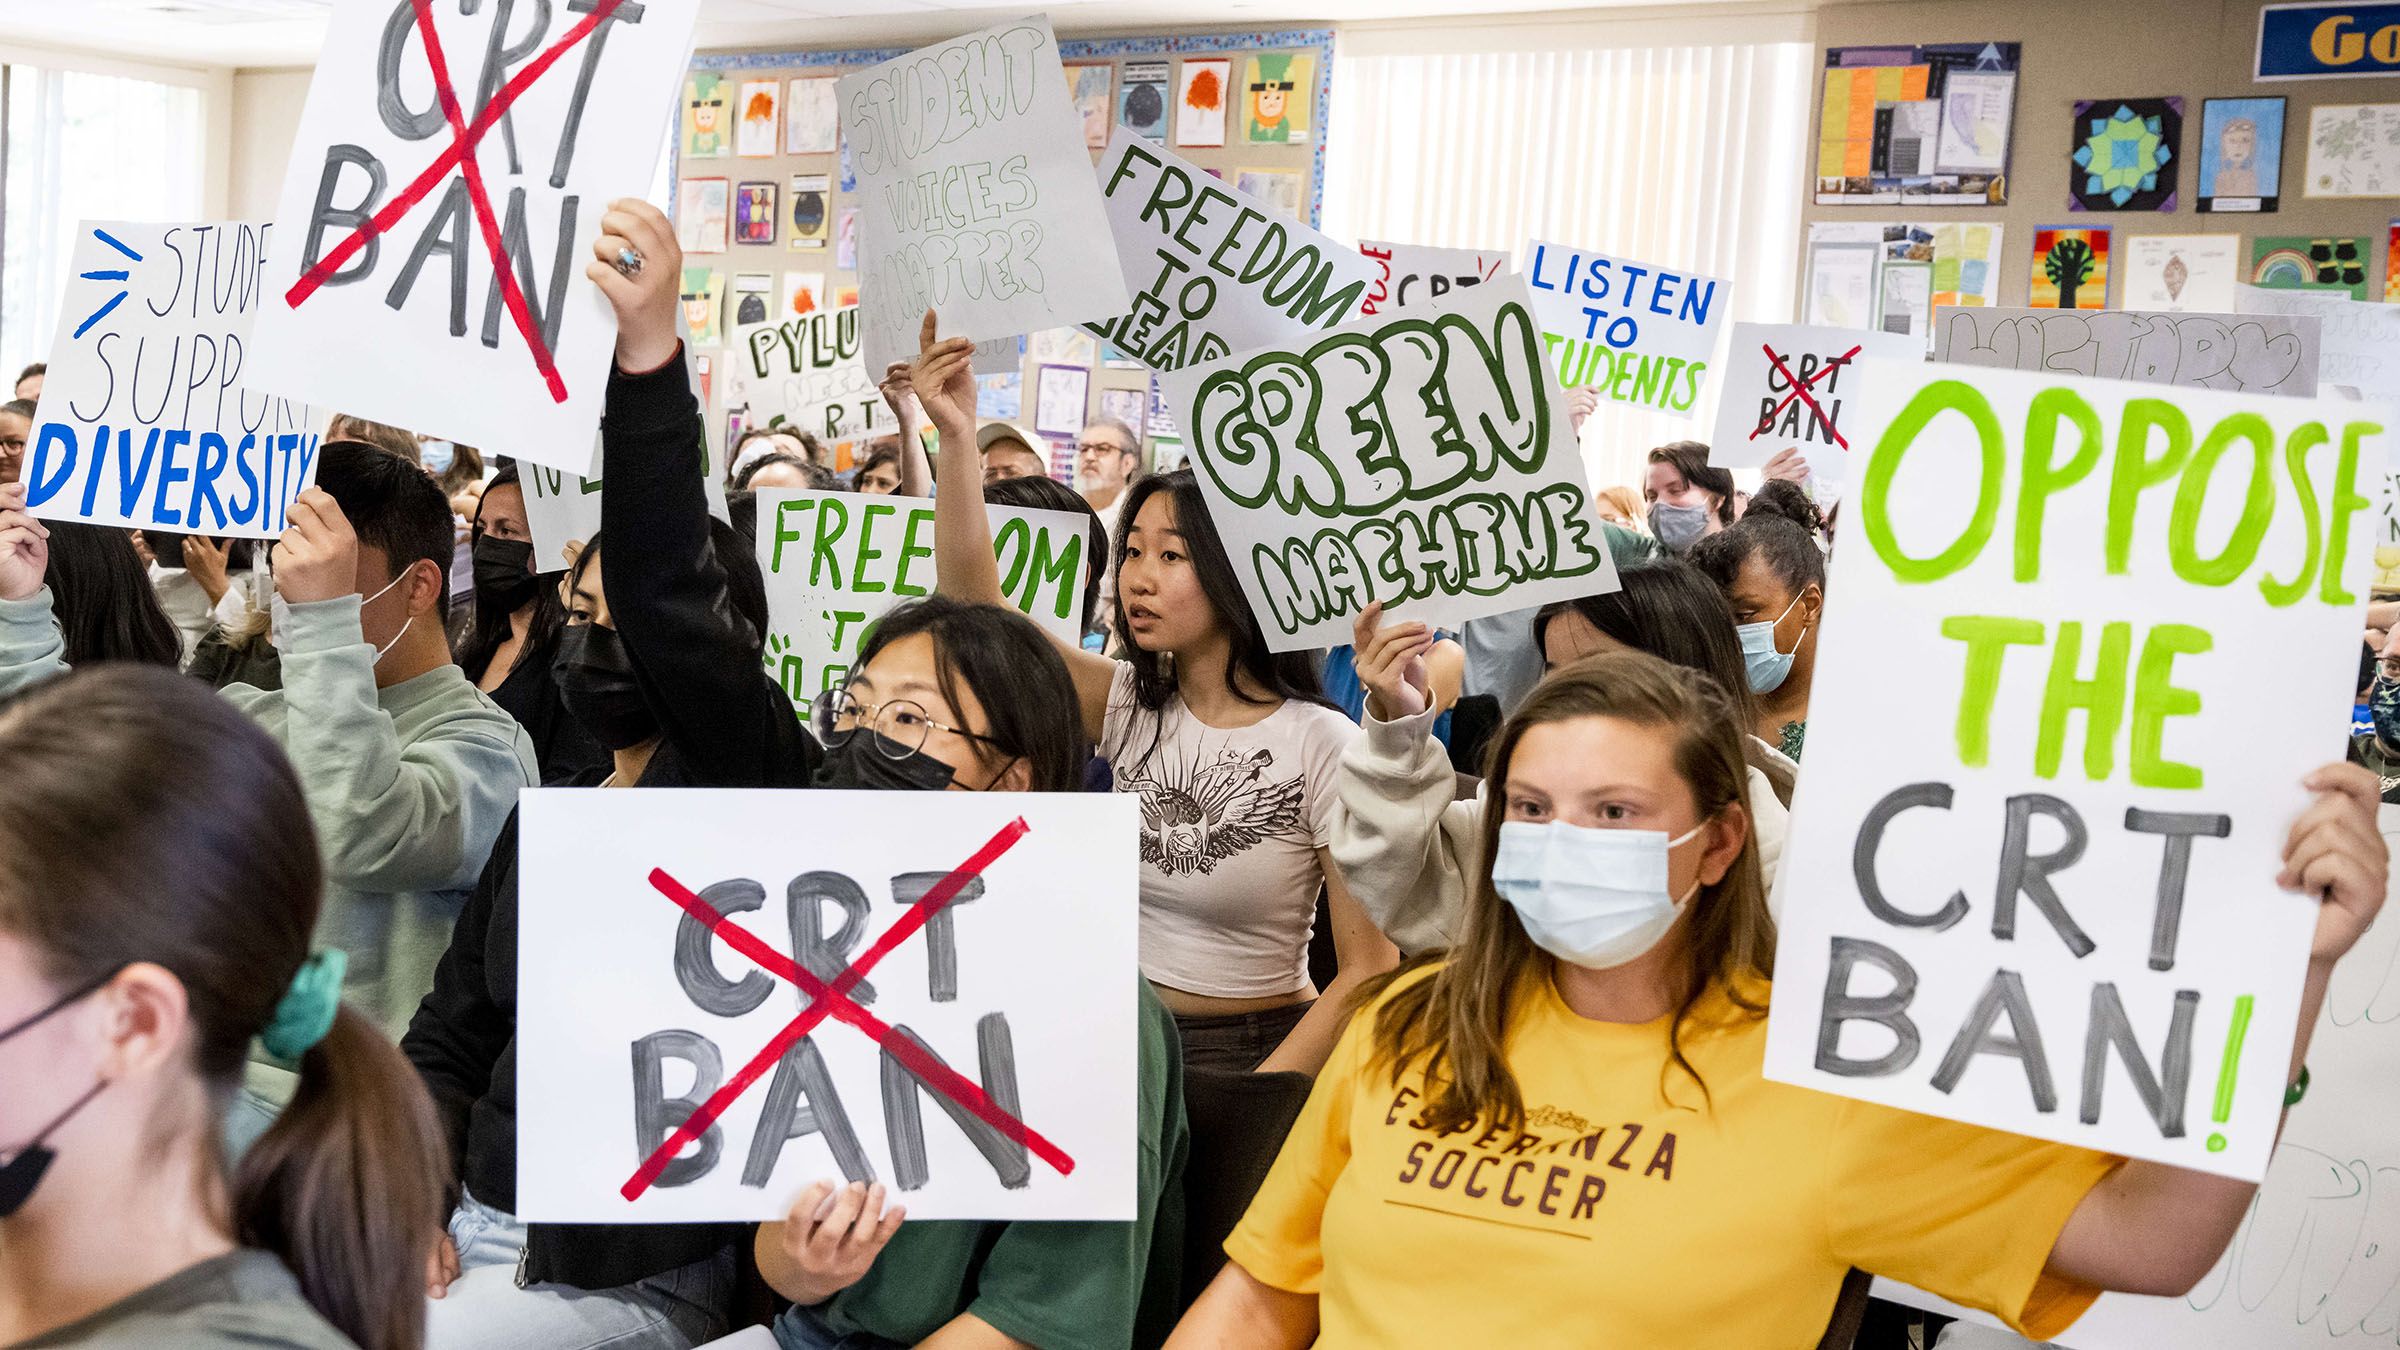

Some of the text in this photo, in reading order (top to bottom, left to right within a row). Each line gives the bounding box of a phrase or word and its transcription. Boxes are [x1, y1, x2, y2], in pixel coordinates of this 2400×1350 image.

[377, 0, 645, 188] CRT
[850, 26, 1046, 176] STUDENT
[302, 144, 579, 353] BAN
[885, 155, 1038, 233] VOICES
[1104, 144, 1366, 331] FREEDOM
[883, 219, 1045, 332] MATTER
[1151, 248, 1217, 321] TO
[1532, 245, 1715, 325] LISTEN
[1583, 307, 1638, 348] TO
[1191, 302, 1551, 518] GREEN
[1757, 397, 1842, 445] BAN
[1768, 353, 1852, 394] CRT
[26, 423, 318, 533] DIVERSITY
[1862, 380, 2384, 607] OPPOSE
[771, 497, 1081, 619] FREEOM
[1252, 482, 1602, 635] MACHINE
[1941, 615, 2215, 790] THE
[673, 870, 986, 1018] CRT
[1852, 781, 2232, 972] CRT
[631, 1012, 1031, 1191] BAN
[1814, 935, 2255, 1153] BAN!
[1398, 1141, 1606, 1219] SOCCER
